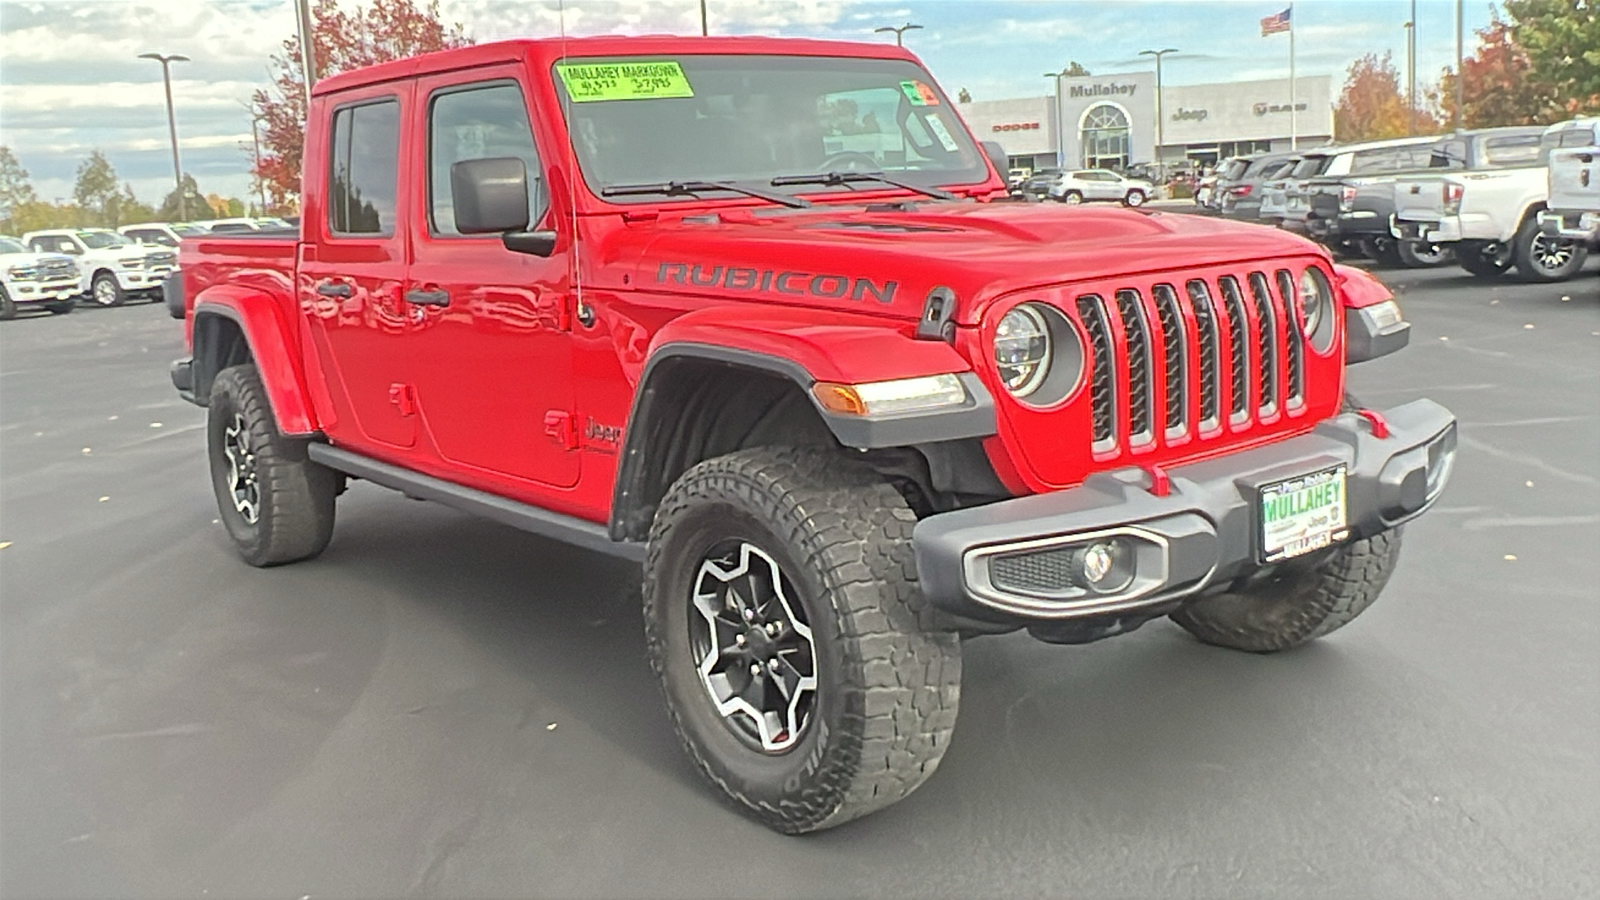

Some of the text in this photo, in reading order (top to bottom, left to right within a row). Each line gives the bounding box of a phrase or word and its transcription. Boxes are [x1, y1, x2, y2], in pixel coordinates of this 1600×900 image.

[568, 64, 679, 80] MULLAHEY MARKDOWN
[1070, 83, 1137, 98] Mullahey
[1171, 107, 1208, 122] Jeep
[992, 122, 1039, 132] DODGE
[656, 262, 898, 304] RUBICON
[584, 415, 621, 448] Jeep
[1264, 482, 1340, 522] MULLAHEY
